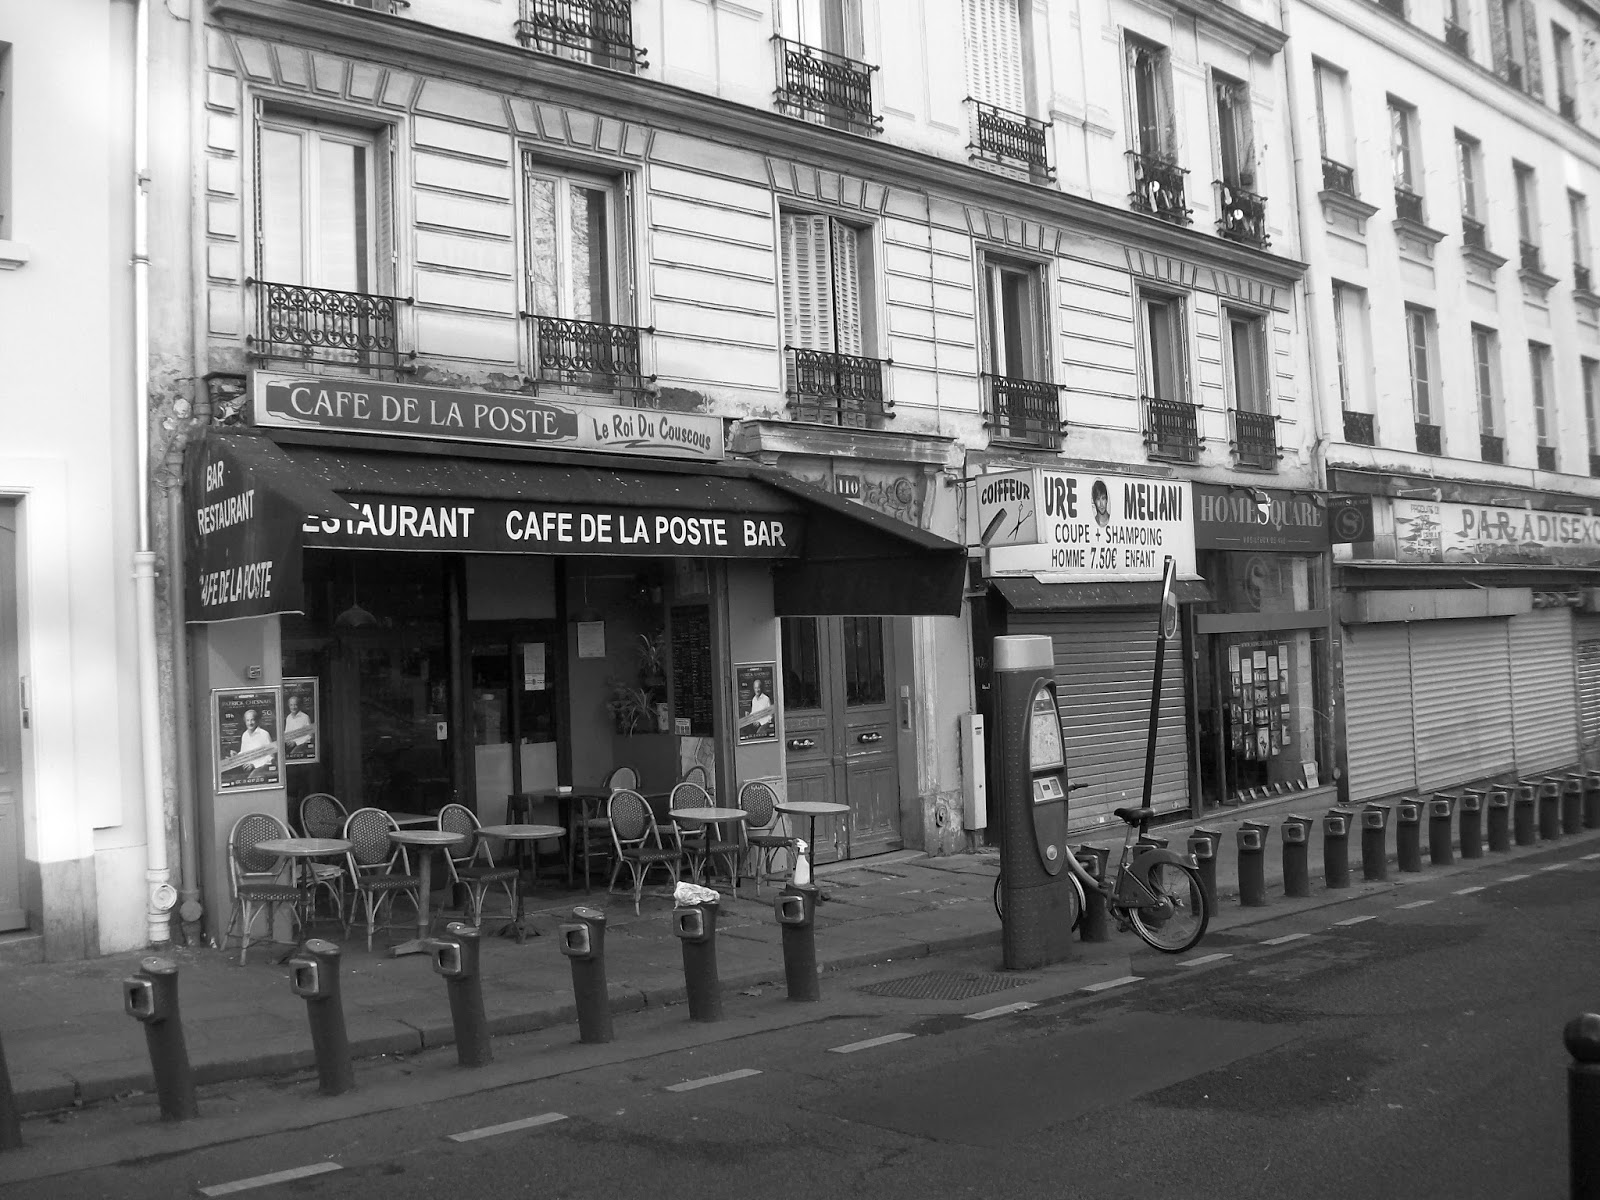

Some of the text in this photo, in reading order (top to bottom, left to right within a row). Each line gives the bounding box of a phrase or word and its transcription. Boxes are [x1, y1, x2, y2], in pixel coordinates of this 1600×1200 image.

[290, 387, 559, 436] CAFE DE LA POSTE
[592, 413, 711, 450] Le Roi Du Couscous
[206, 460, 225, 493] BAR
[840, 479, 857, 495] 110
[981, 478, 1031, 505] COIFFEUR
[197, 489, 255, 536] RESTAURANT
[1124, 482, 1183, 522] MELIANI
[302, 503, 787, 547] ESTAURANT CAFE DE LA POSTE BAR
[1055, 523, 1090, 544] COUPE
[1105, 525, 1163, 547] SHAMPOING
[1051, 547, 1156, 570] HOMME 7.50€ ENFANT
[218, 567, 231, 605] DE
[230, 565, 243, 602] LA
[242, 560, 273, 601] POSTE
